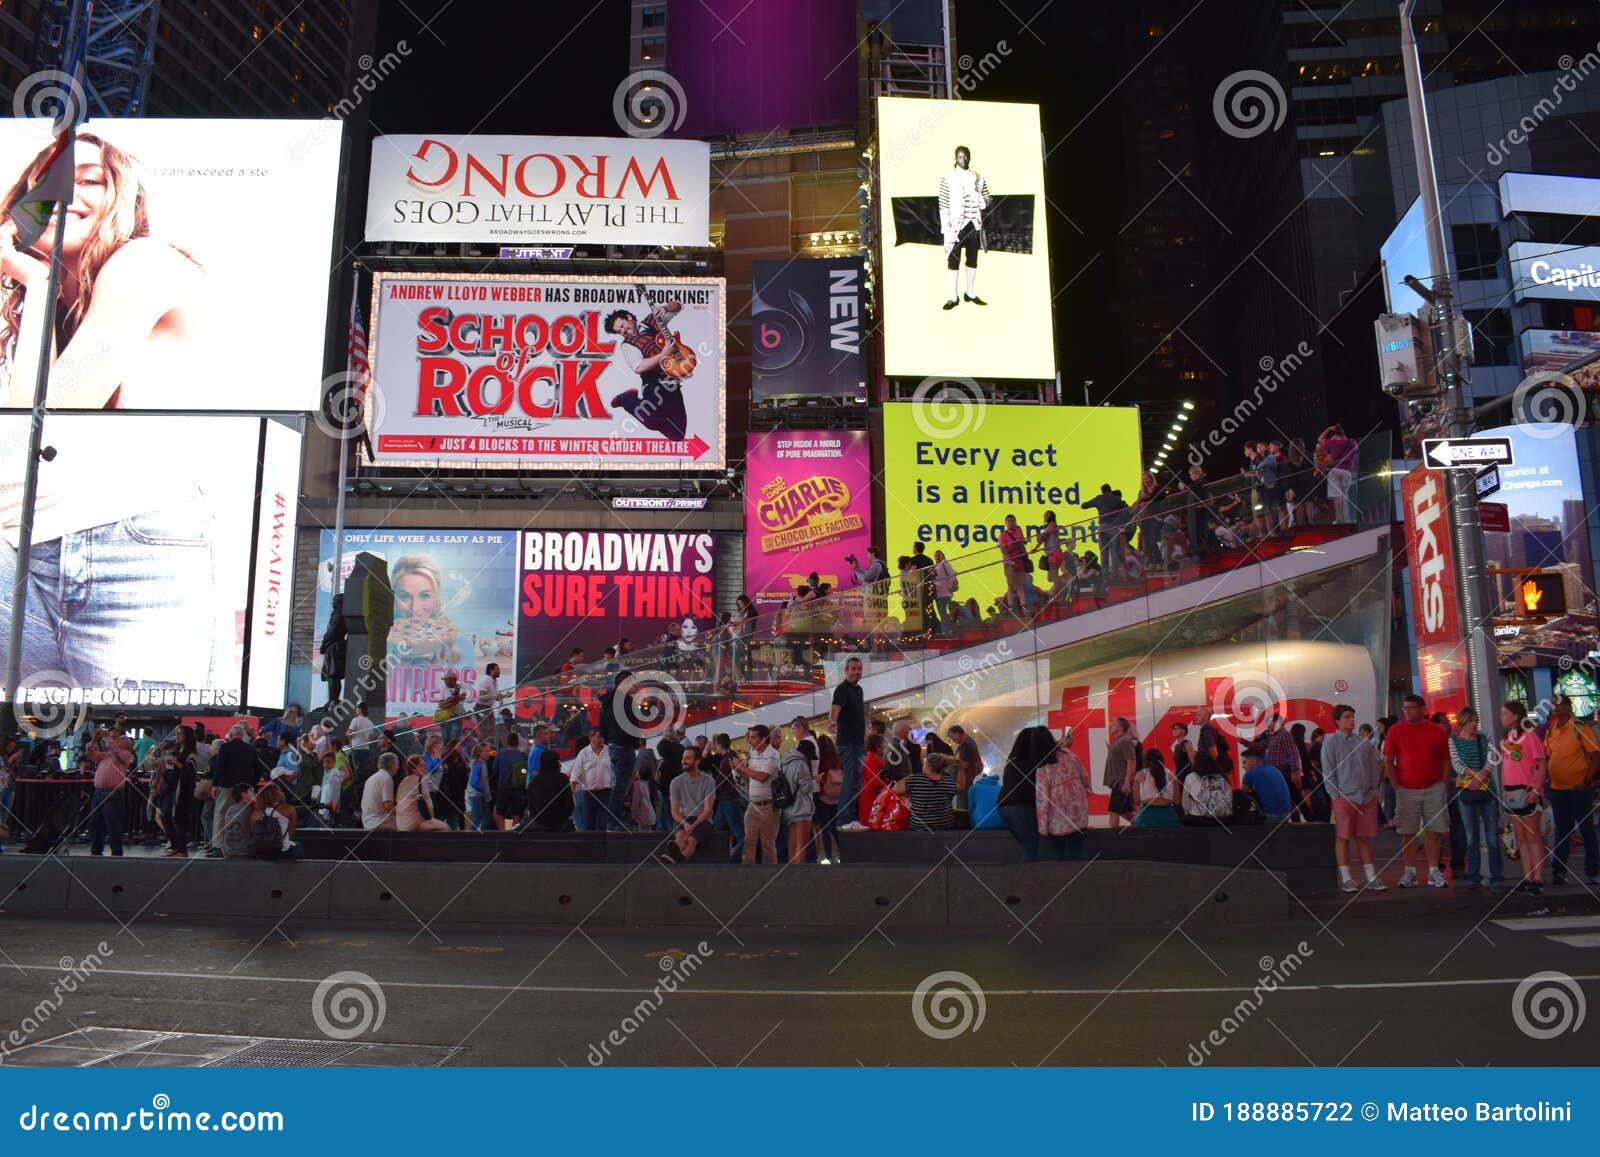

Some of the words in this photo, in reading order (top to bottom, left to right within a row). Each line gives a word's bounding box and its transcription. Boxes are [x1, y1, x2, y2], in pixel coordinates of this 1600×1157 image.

[188, 167, 234, 176] exceed
[406, 139, 682, 200] WRONG
[393, 200, 480, 224] GOES
[485, 204, 552, 222] THAT
[557, 203, 626, 227] PLAY
[635, 206, 684, 224] THE
[447, 285, 488, 301] LLOYD
[491, 286, 542, 302] WEBBER
[545, 287, 570, 303] HAS
[574, 288, 643, 304] BROADWAY
[829, 268, 860, 355] NEW
[416, 306, 616, 354] SCHOOL
[495, 345, 536, 381] of
[416, 356, 614, 419] ROCK
[496, 419, 533, 428] MUSICAL
[439, 438, 467, 450] JUST
[469, 438, 476, 450] 4
[478, 439, 519, 451] BLOCKS
[521, 439, 534, 451] TO
[537, 439, 556, 452] THE
[560, 440, 599, 452] WINTER
[602, 440, 643, 453] GARDEN
[645, 441, 689, 453] THEATRE
[776, 440, 792, 449] STEP
[819, 440, 841, 448] WORLD
[776, 450, 784, 458] OF
[786, 450, 801, 458] PURE
[916, 442, 1000, 471] Every
[1011, 443, 1057, 467] act
[1452, 447, 1475, 459] ONE
[1480, 447, 1503, 457] WAY
[760, 477, 845, 527] CHARLIE
[916, 479, 941, 503] is
[952, 486, 968, 504] a
[980, 480, 1080, 504] limited
[344, 534, 372, 543] ONLY
[374, 535, 394, 543] LIFE
[399, 535, 425, 543] WERE
[428, 535, 441, 543] AS
[443, 535, 469, 543] EASY
[486, 536, 502, 544] PIE
[774, 523, 825, 547] CHOCOLATE
[826, 517, 860, 534] FACTORY
[917, 519, 1100, 548] engament
[523, 531, 714, 574] BROADWAY'S
[1412, 475, 1445, 634] tkts
[522, 573, 606, 618] SURE
[613, 575, 713, 619] THING
[26, 688, 89, 705] EAGLE
[100, 688, 239, 706] OUTFITTERS
[386, 665, 477, 705] ITRES
